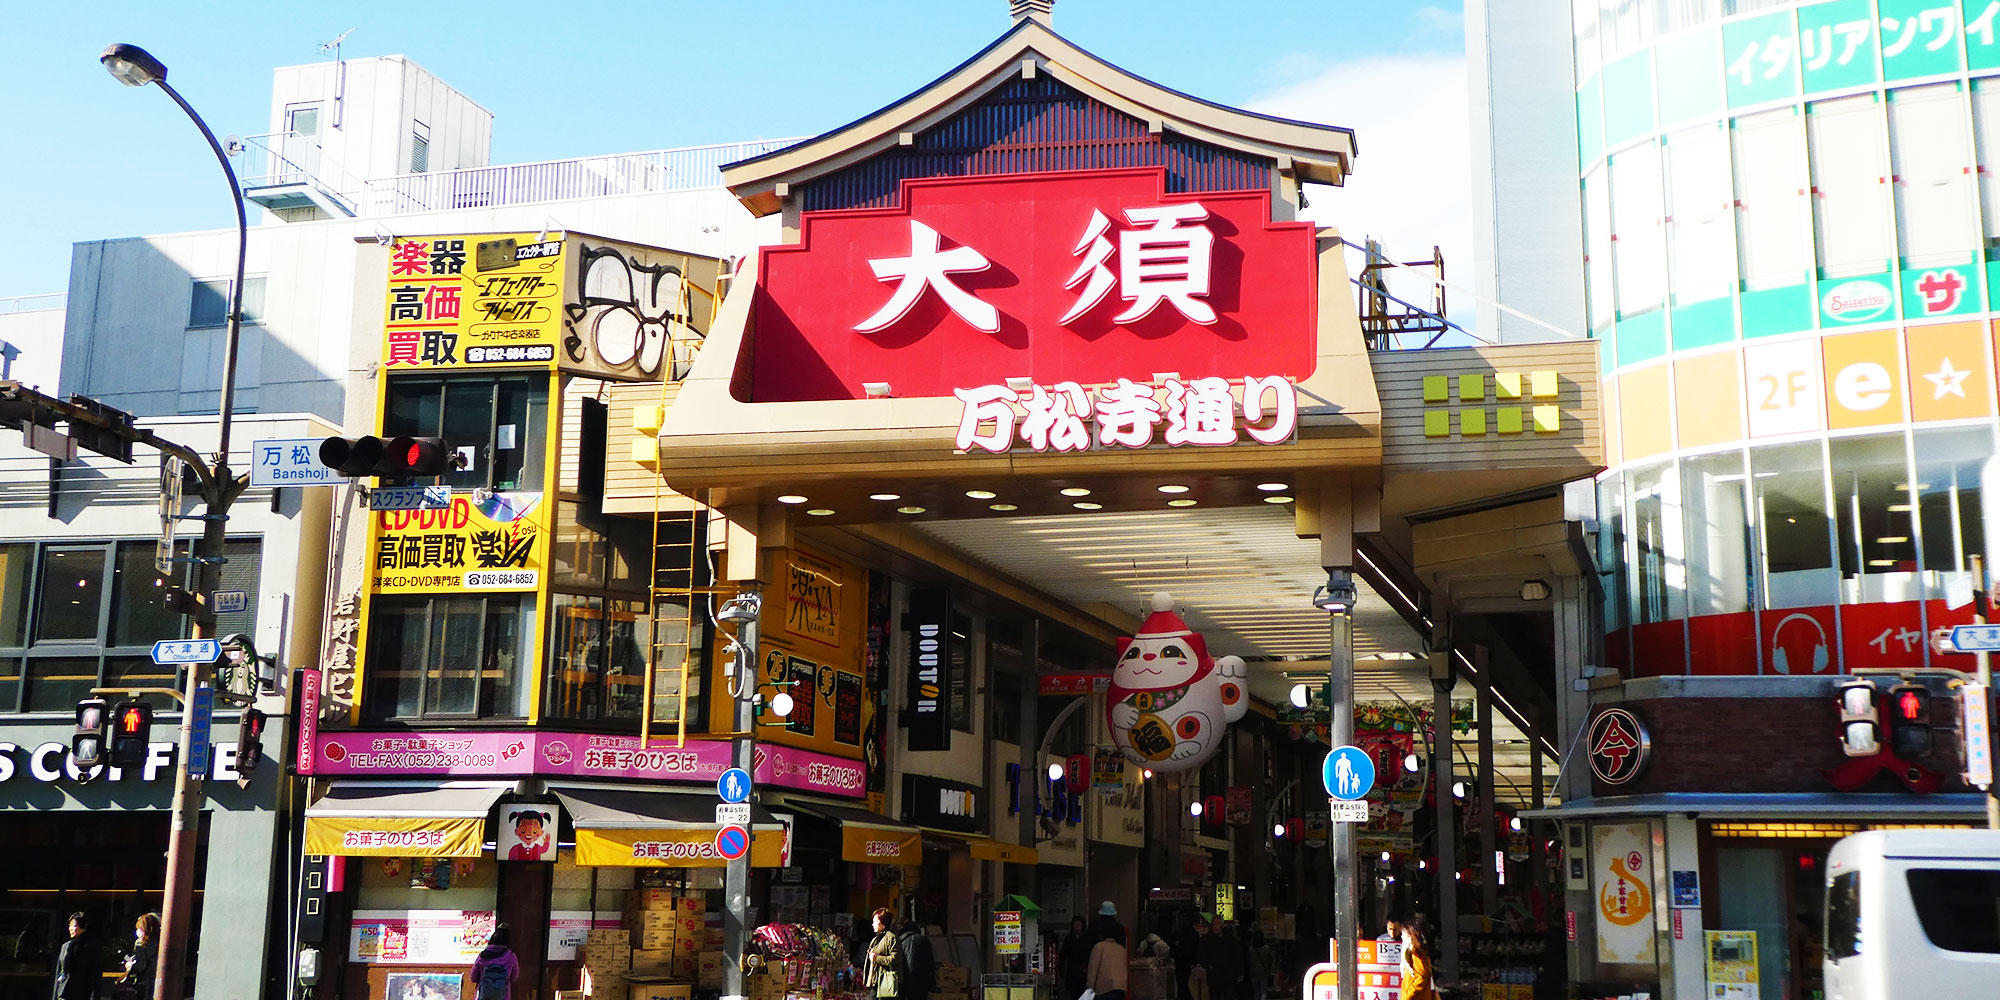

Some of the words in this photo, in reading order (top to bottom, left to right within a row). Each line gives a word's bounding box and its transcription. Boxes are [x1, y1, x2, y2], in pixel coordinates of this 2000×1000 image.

[392, 240, 467, 275] 楽器
[852, 202, 1218, 334] 大須
[390, 284, 462, 320] 高価
[479, 276, 546, 296] エフェクター
[1918, 272, 1963, 313] サ
[483, 301, 538, 321] フリークス
[385, 330, 458, 366] 買取
[1758, 370, 1807, 411] 2F
[953, 375, 1298, 453] 万松寺通り
[262, 445, 311, 466] 万松
[273, 467, 330, 480] Banshoji
[376, 533, 466, 570] 高価買取
[482, 572, 534, 585] 052-684-6852
[164, 643, 210, 654] 大津通
[1869, 624, 1922, 654] イヤ
[917, 624, 940, 712] DOUTOR
[301, 673, 316, 770] お菓子のひろば
[30, 742, 240, 782] CFE
[585, 750, 698, 773] お菓子のひろば
[808, 763, 857, 790] お菓子のひろば
[344, 832, 445, 847] お菓子のひろば
